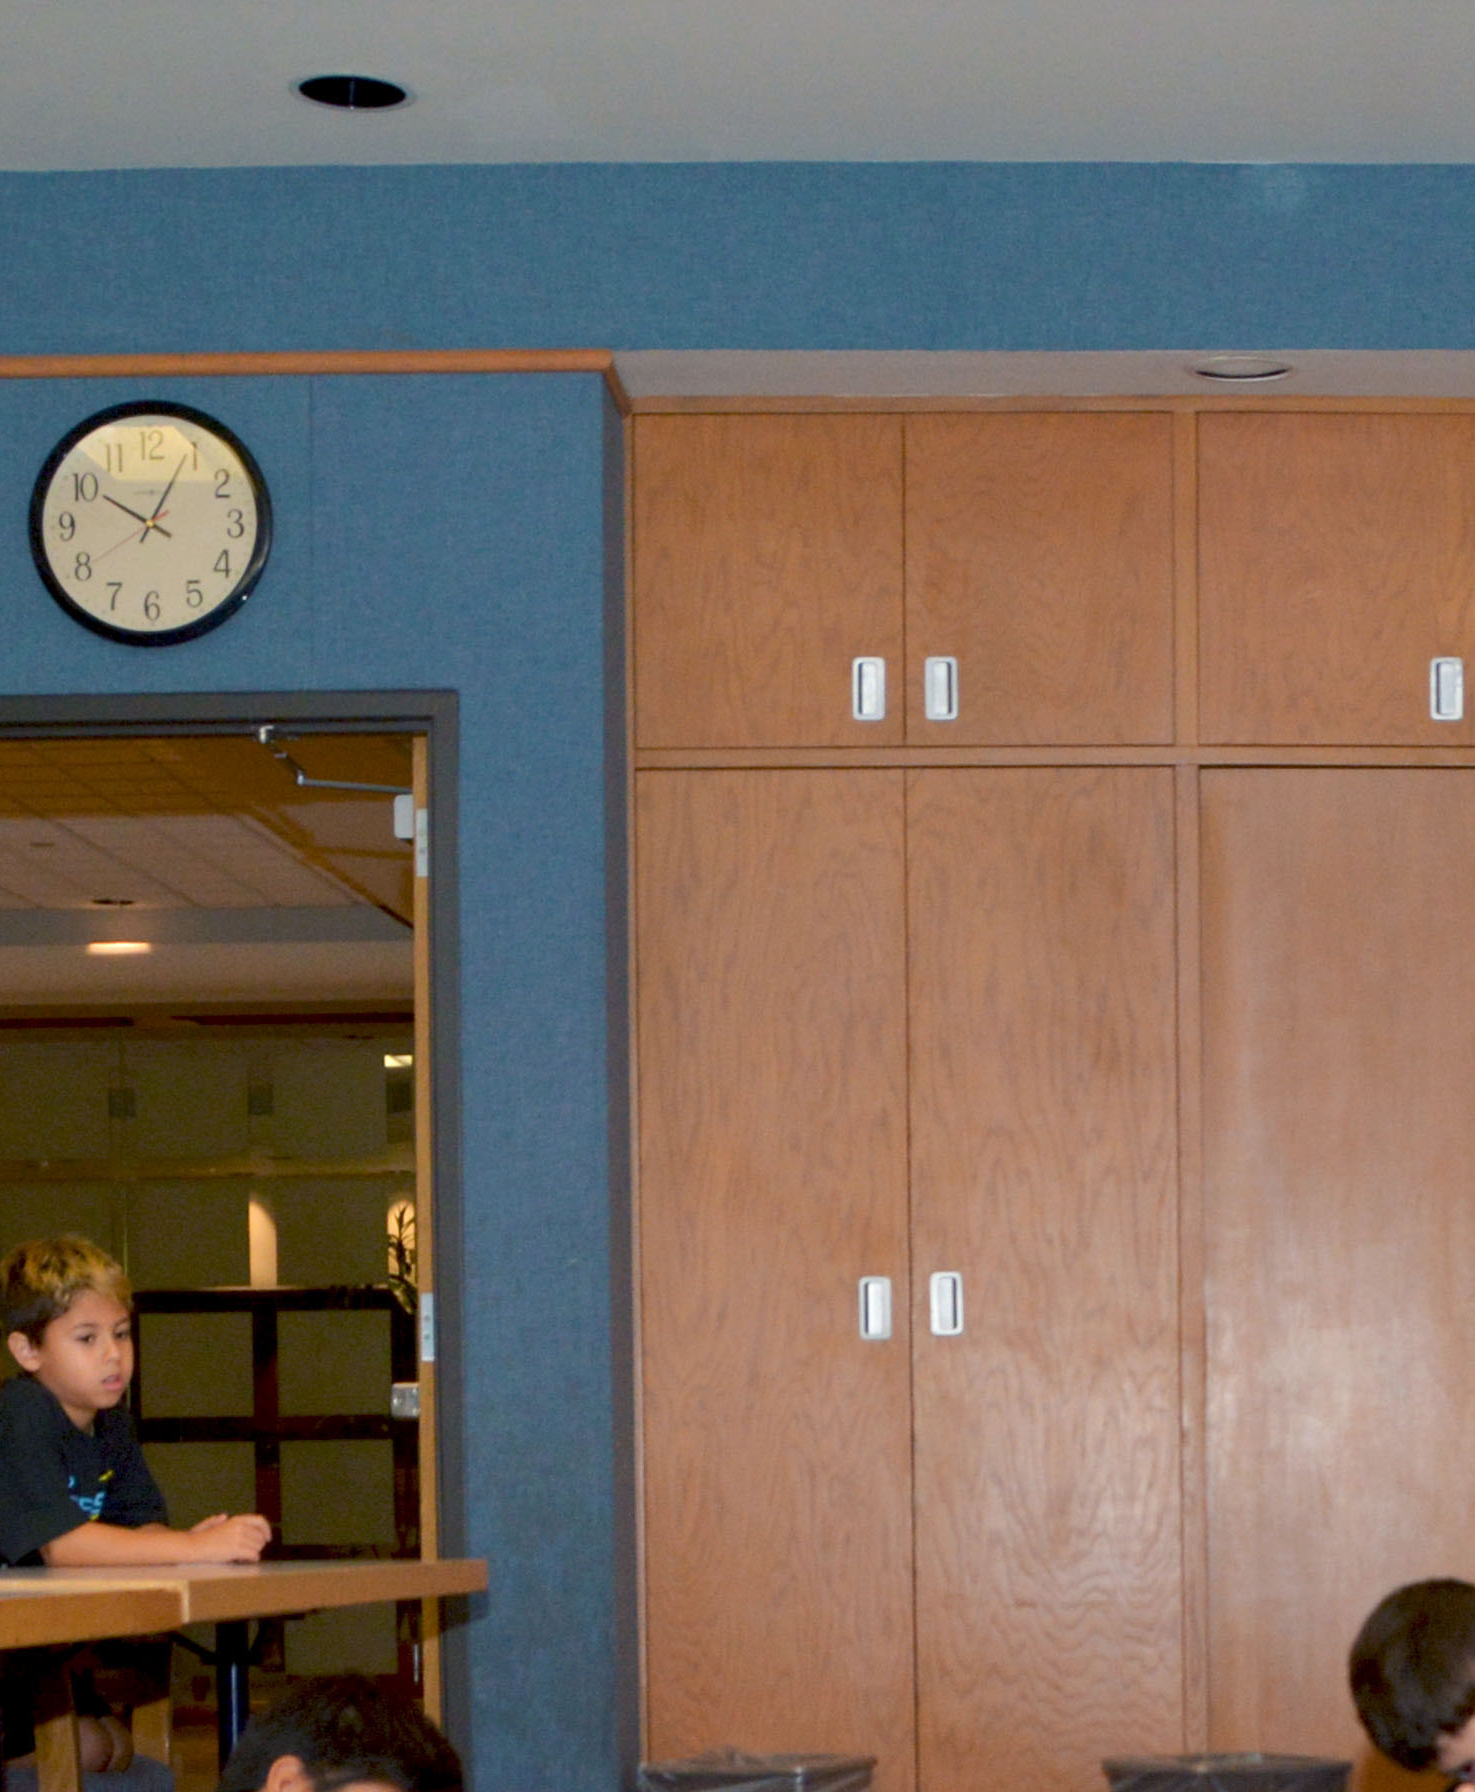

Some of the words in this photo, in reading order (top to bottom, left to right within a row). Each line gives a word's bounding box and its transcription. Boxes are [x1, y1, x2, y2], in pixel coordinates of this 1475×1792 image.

[104, 442, 125, 473] 11
[139, 429, 165, 461] 12
[190, 441, 199, 472] 1
[73, 472, 100, 503] 10
[214, 468, 231, 499] 2
[58, 511, 76, 542] 9
[226, 508, 246, 539] 3
[74, 551, 93, 582] 8
[213, 549, 231, 579] 4
[106, 581, 123, 612] 7
[143, 590, 162, 622] 6
[185, 579, 204, 609] 5
